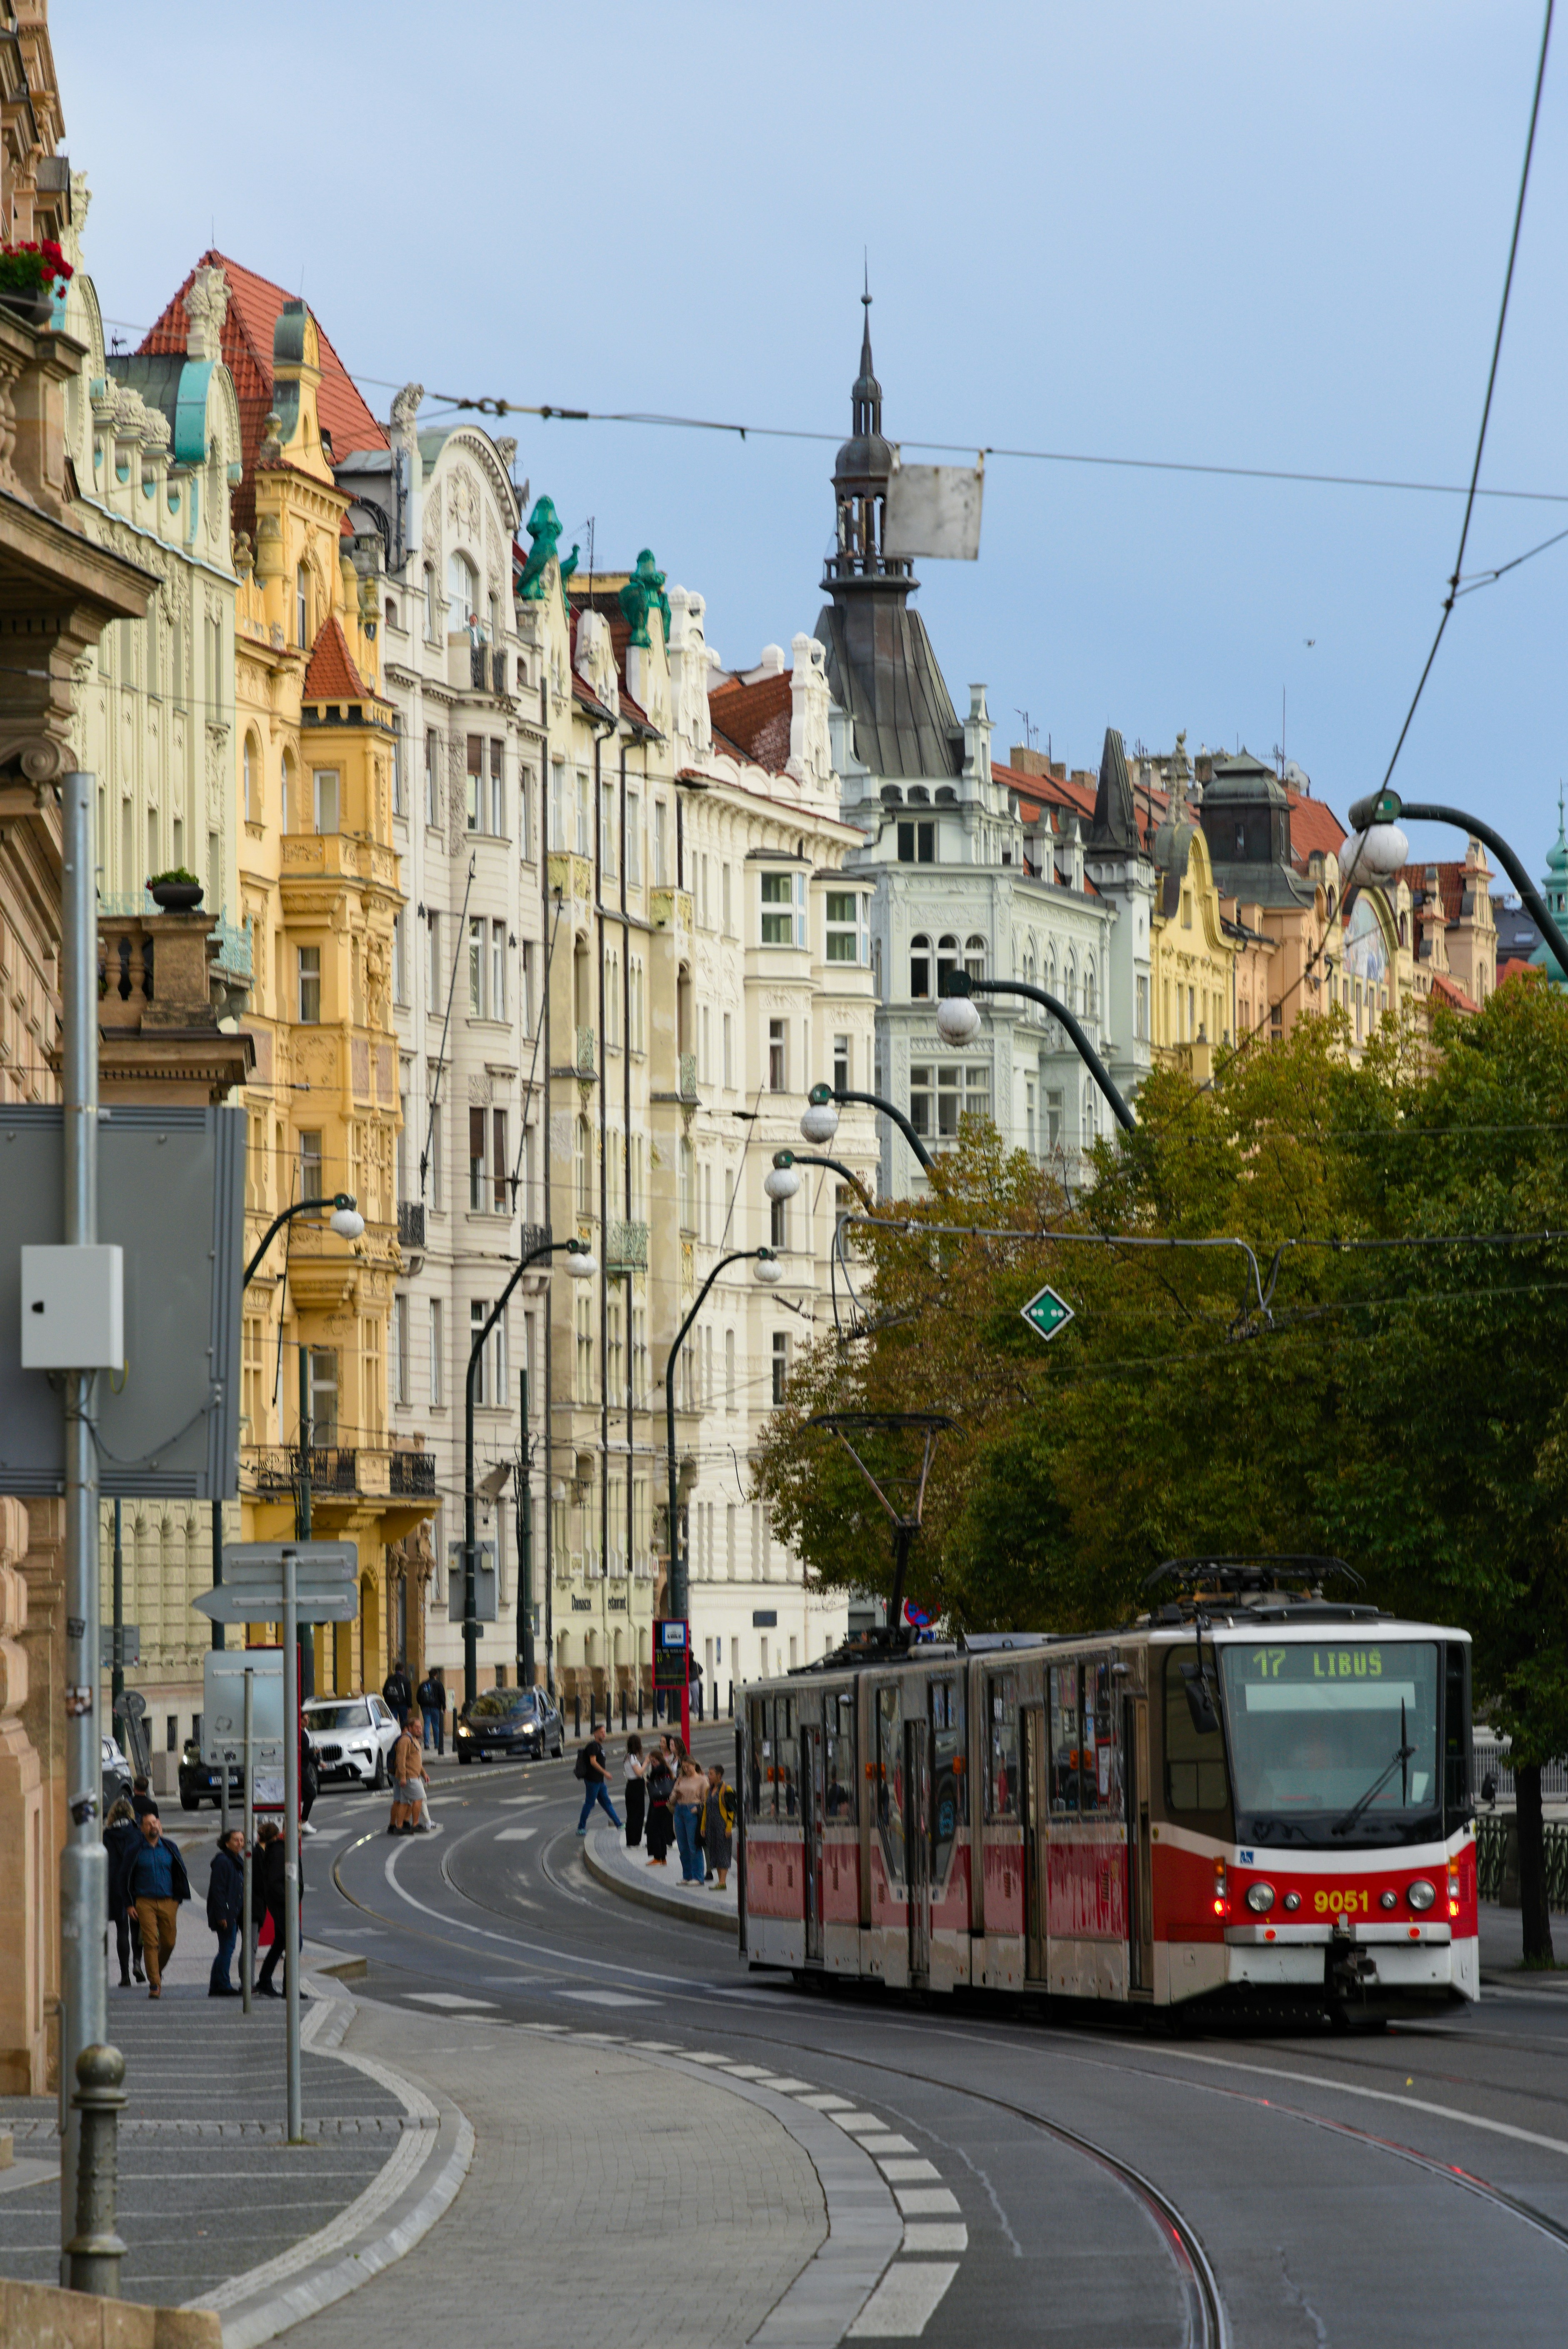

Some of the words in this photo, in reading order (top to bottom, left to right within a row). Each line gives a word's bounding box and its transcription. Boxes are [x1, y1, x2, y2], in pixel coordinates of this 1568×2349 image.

[1253, 1648, 1286, 1678] 17
[1314, 1647, 1382, 1677] LIBUŠ
[1314, 1889, 1368, 1914] 9051
